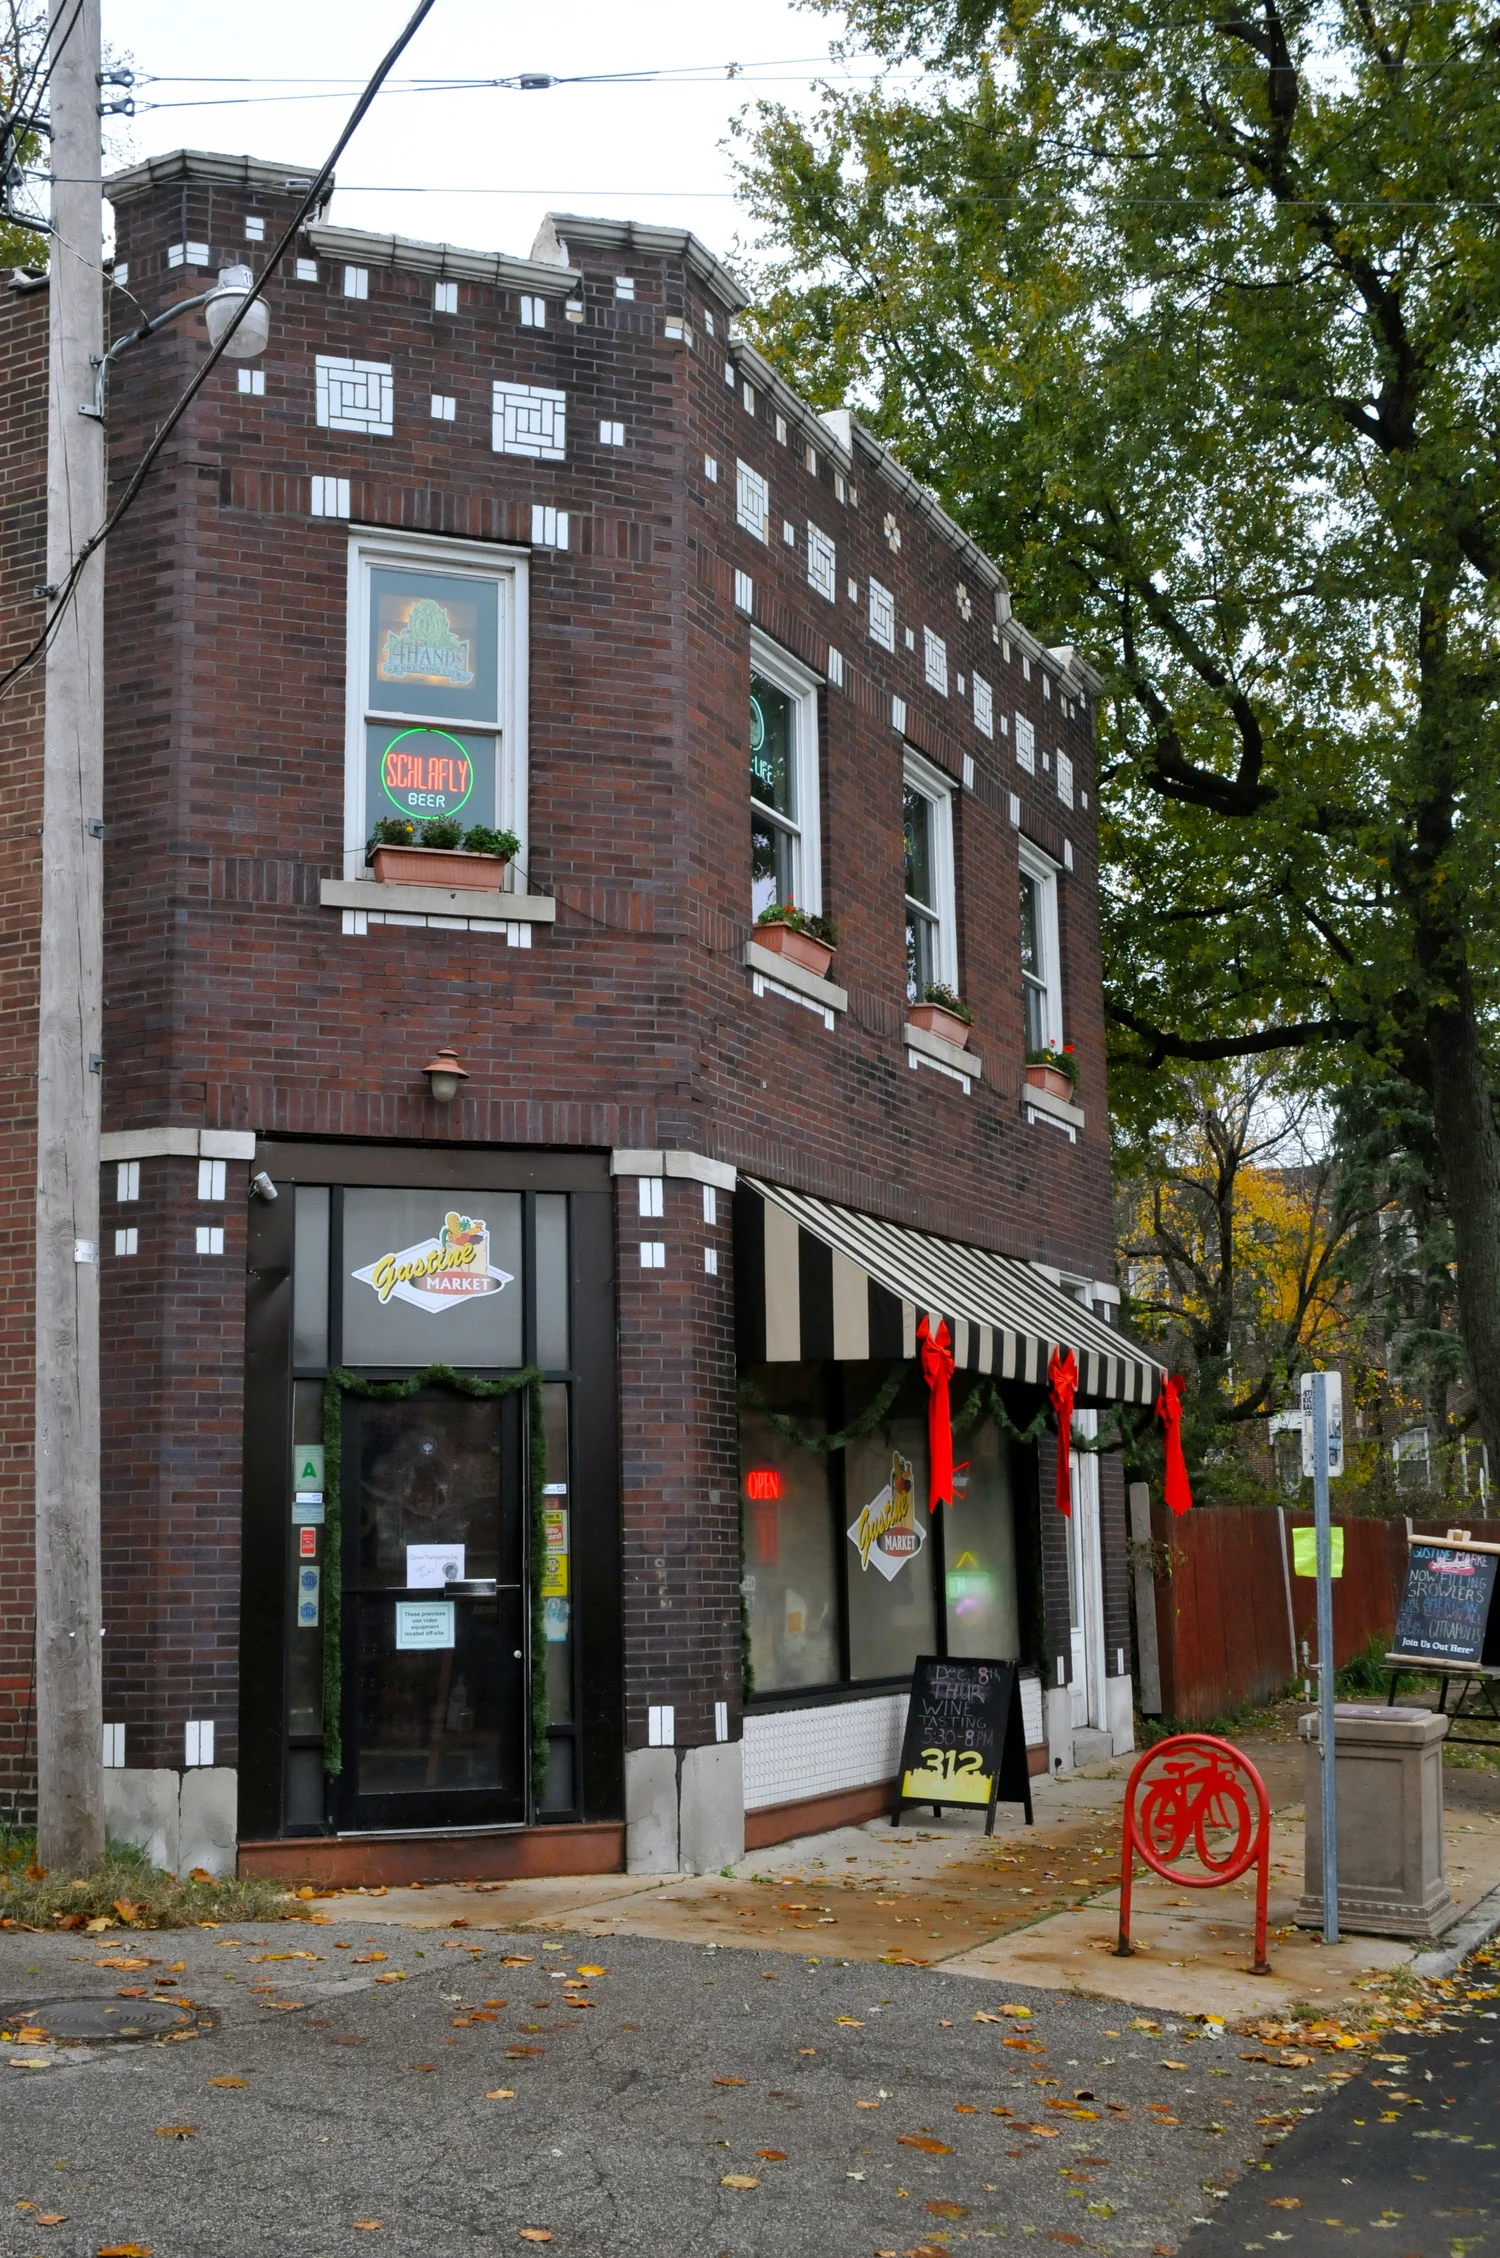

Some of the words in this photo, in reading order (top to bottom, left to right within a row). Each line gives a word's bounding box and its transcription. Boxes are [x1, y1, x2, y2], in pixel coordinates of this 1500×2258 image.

[386, 753, 468, 793] SCHLAFLY
[407, 792, 446, 808] BEER
[371, 1242, 476, 1300] Gustine
[426, 1277, 490, 1291] MARKET
[302, 1461, 317, 1478] A
[749, 1471, 779, 1499] OPEN
[857, 1493, 910, 1568] Gustine
[885, 1534, 916, 1551] MARKET
[1409, 1569, 1438, 1582] NOW
[1440, 1572, 1487, 1589] FILLING
[1407, 1581, 1484, 1603] GROWLERS
[1424, 1596, 1478, 1613] AMERICAN
[1402, 1637, 1419, 1647] Join
[1420, 1640, 1430, 1649] Us
[1432, 1642, 1448, 1651] Out
[978, 1666, 1001, 1685] 8th
[930, 1681, 985, 1703] THUR
[922, 1698, 973, 1717] WINE
[918, 1714, 987, 1729] TASTING
[920, 1747, 984, 1779] 312
